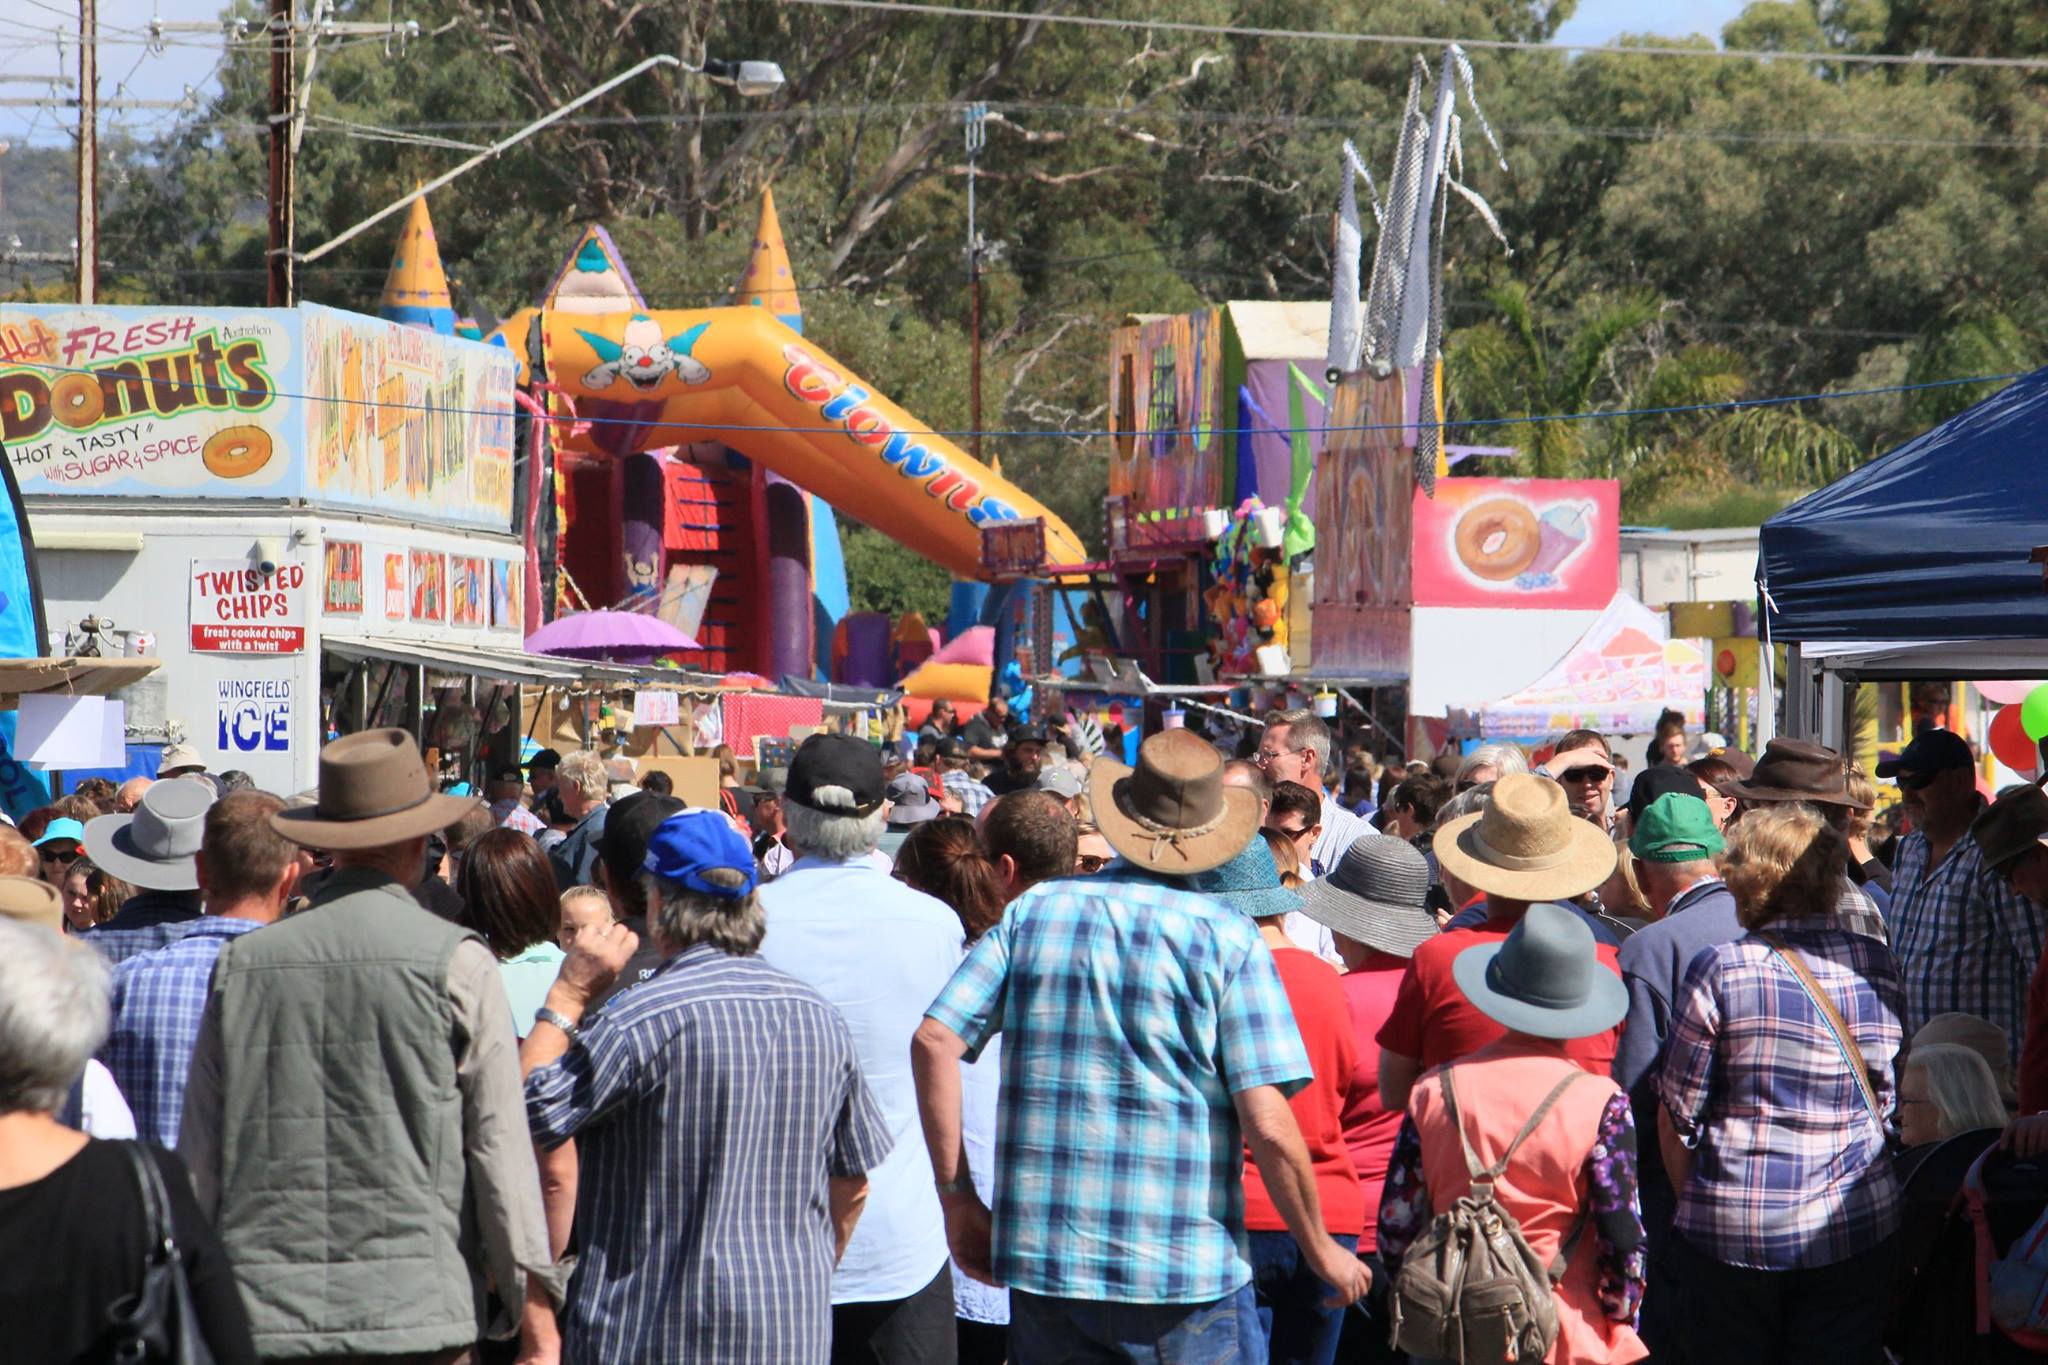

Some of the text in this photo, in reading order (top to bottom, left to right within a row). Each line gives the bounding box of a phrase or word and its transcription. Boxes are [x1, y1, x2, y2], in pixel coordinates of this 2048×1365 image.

[62, 316, 196, 366] FRESH
[13, 443, 53, 466] HOT
[62, 445, 78, 459] &
[64, 450, 134, 481] SUGAR
[143, 435, 202, 463] SPICE
[216, 592, 288, 621] CHIPS
[203, 626, 297, 642] fresh cooked chips
[219, 640, 280, 652] with a twist
[218, 680, 290, 699] WINGFIELD
[218, 699, 290, 752] ICE
